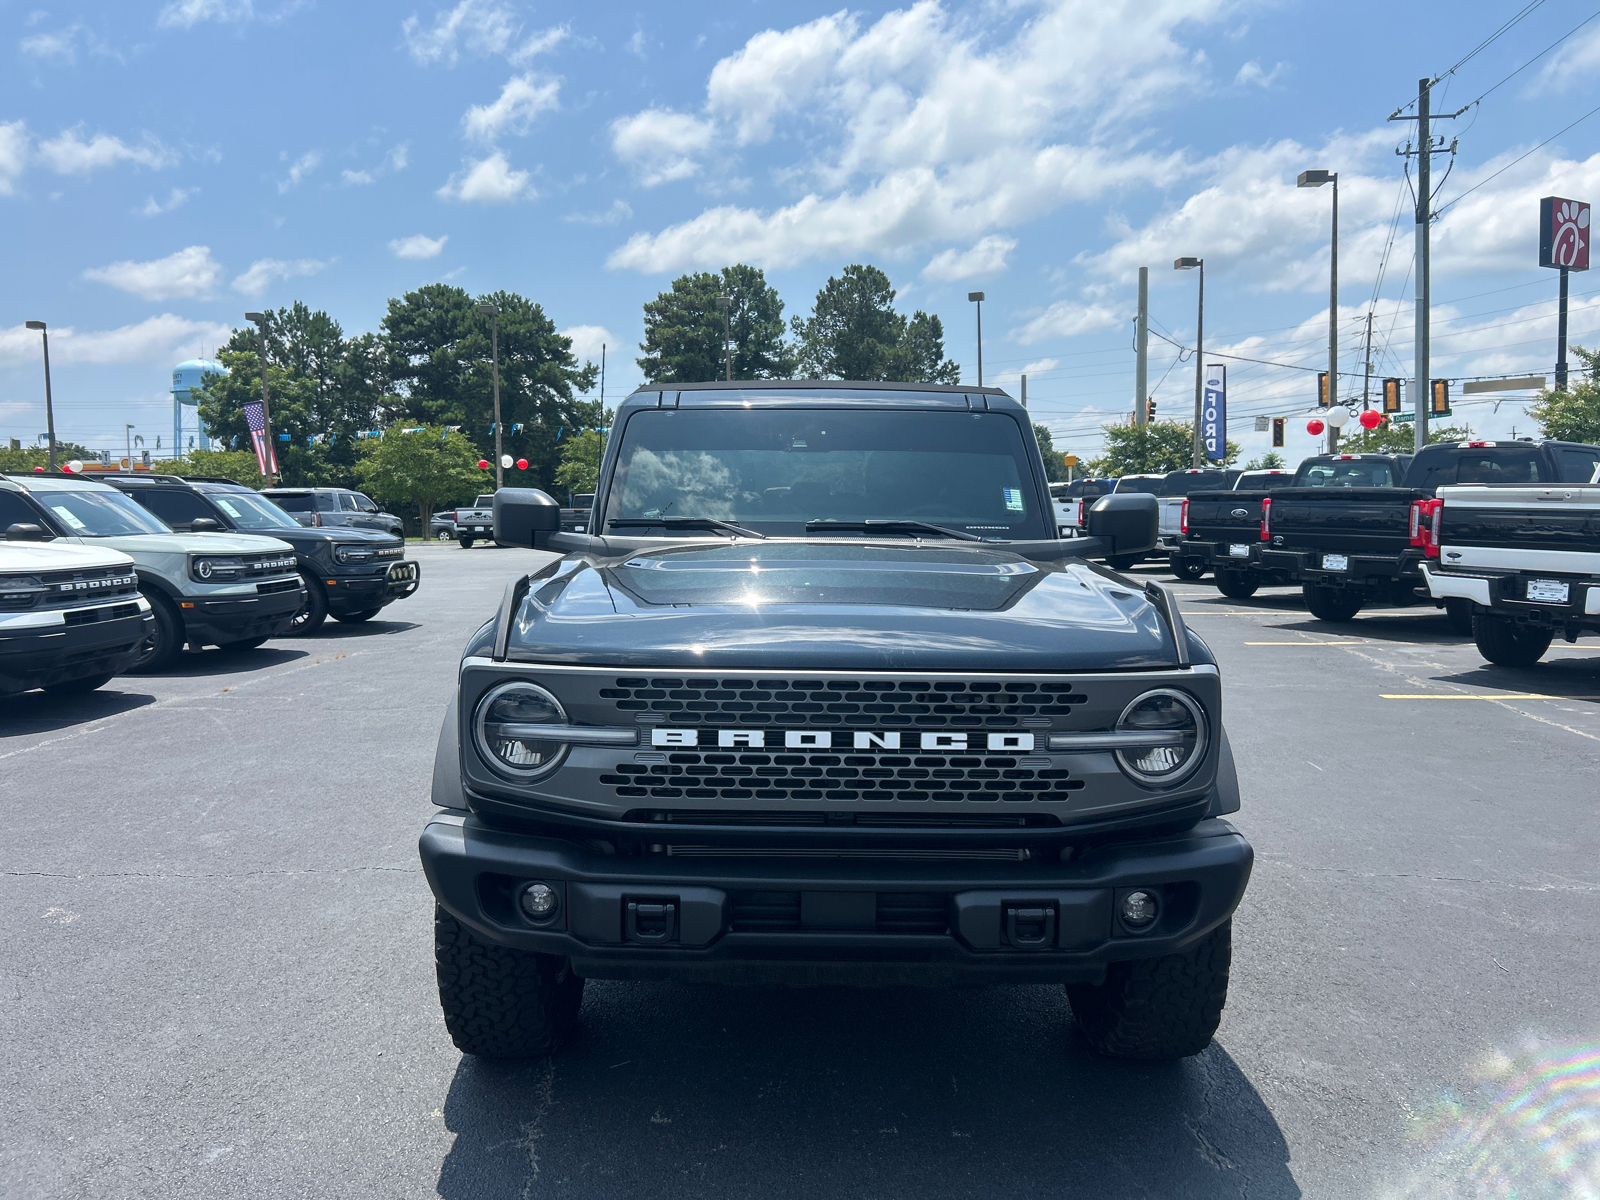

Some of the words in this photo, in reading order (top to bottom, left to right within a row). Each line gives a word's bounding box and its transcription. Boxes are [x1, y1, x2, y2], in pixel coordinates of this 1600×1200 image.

[253, 560, 295, 569] BRONCO
[60, 577, 131, 591] BRONCO
[651, 728, 1035, 751] BRONCO
